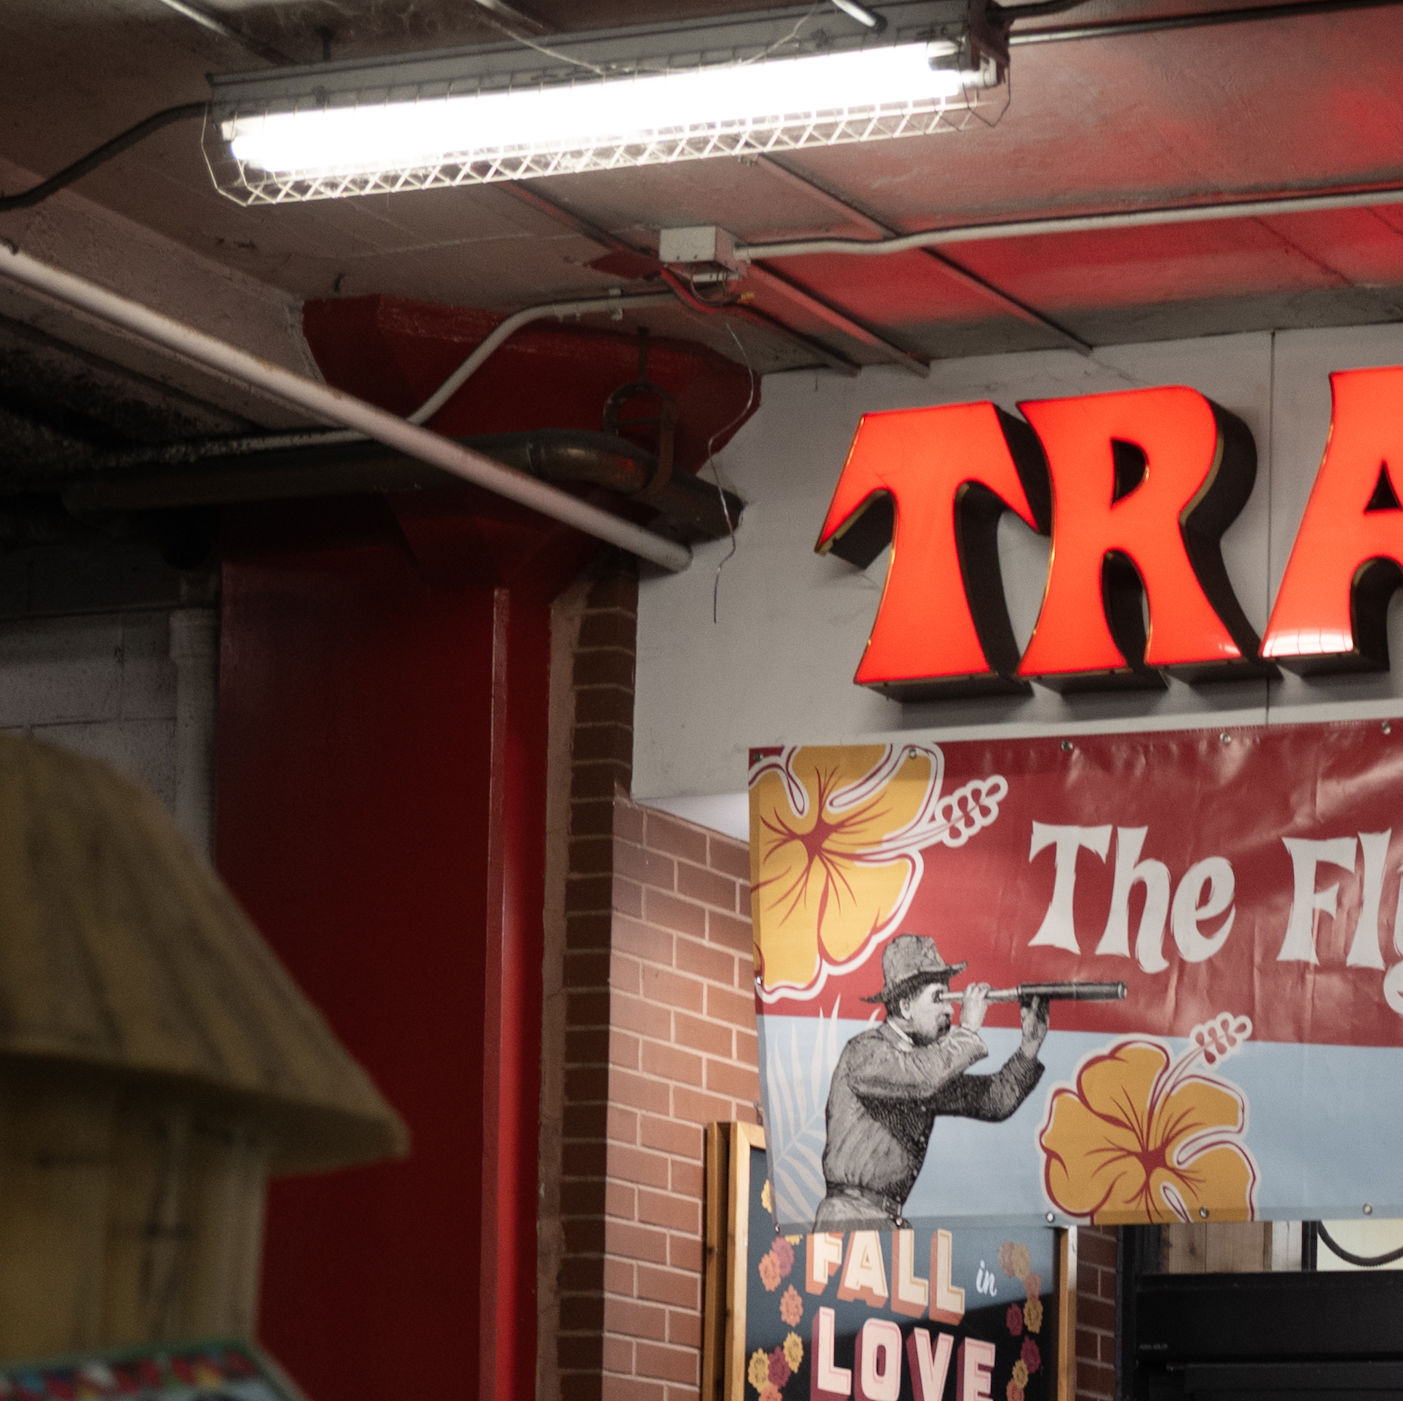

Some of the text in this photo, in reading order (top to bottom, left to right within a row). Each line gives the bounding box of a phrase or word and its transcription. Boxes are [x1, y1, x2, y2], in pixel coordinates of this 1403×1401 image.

[1028, 821, 1237, 974] The
[805, 1229, 998, 1325] FALL in
